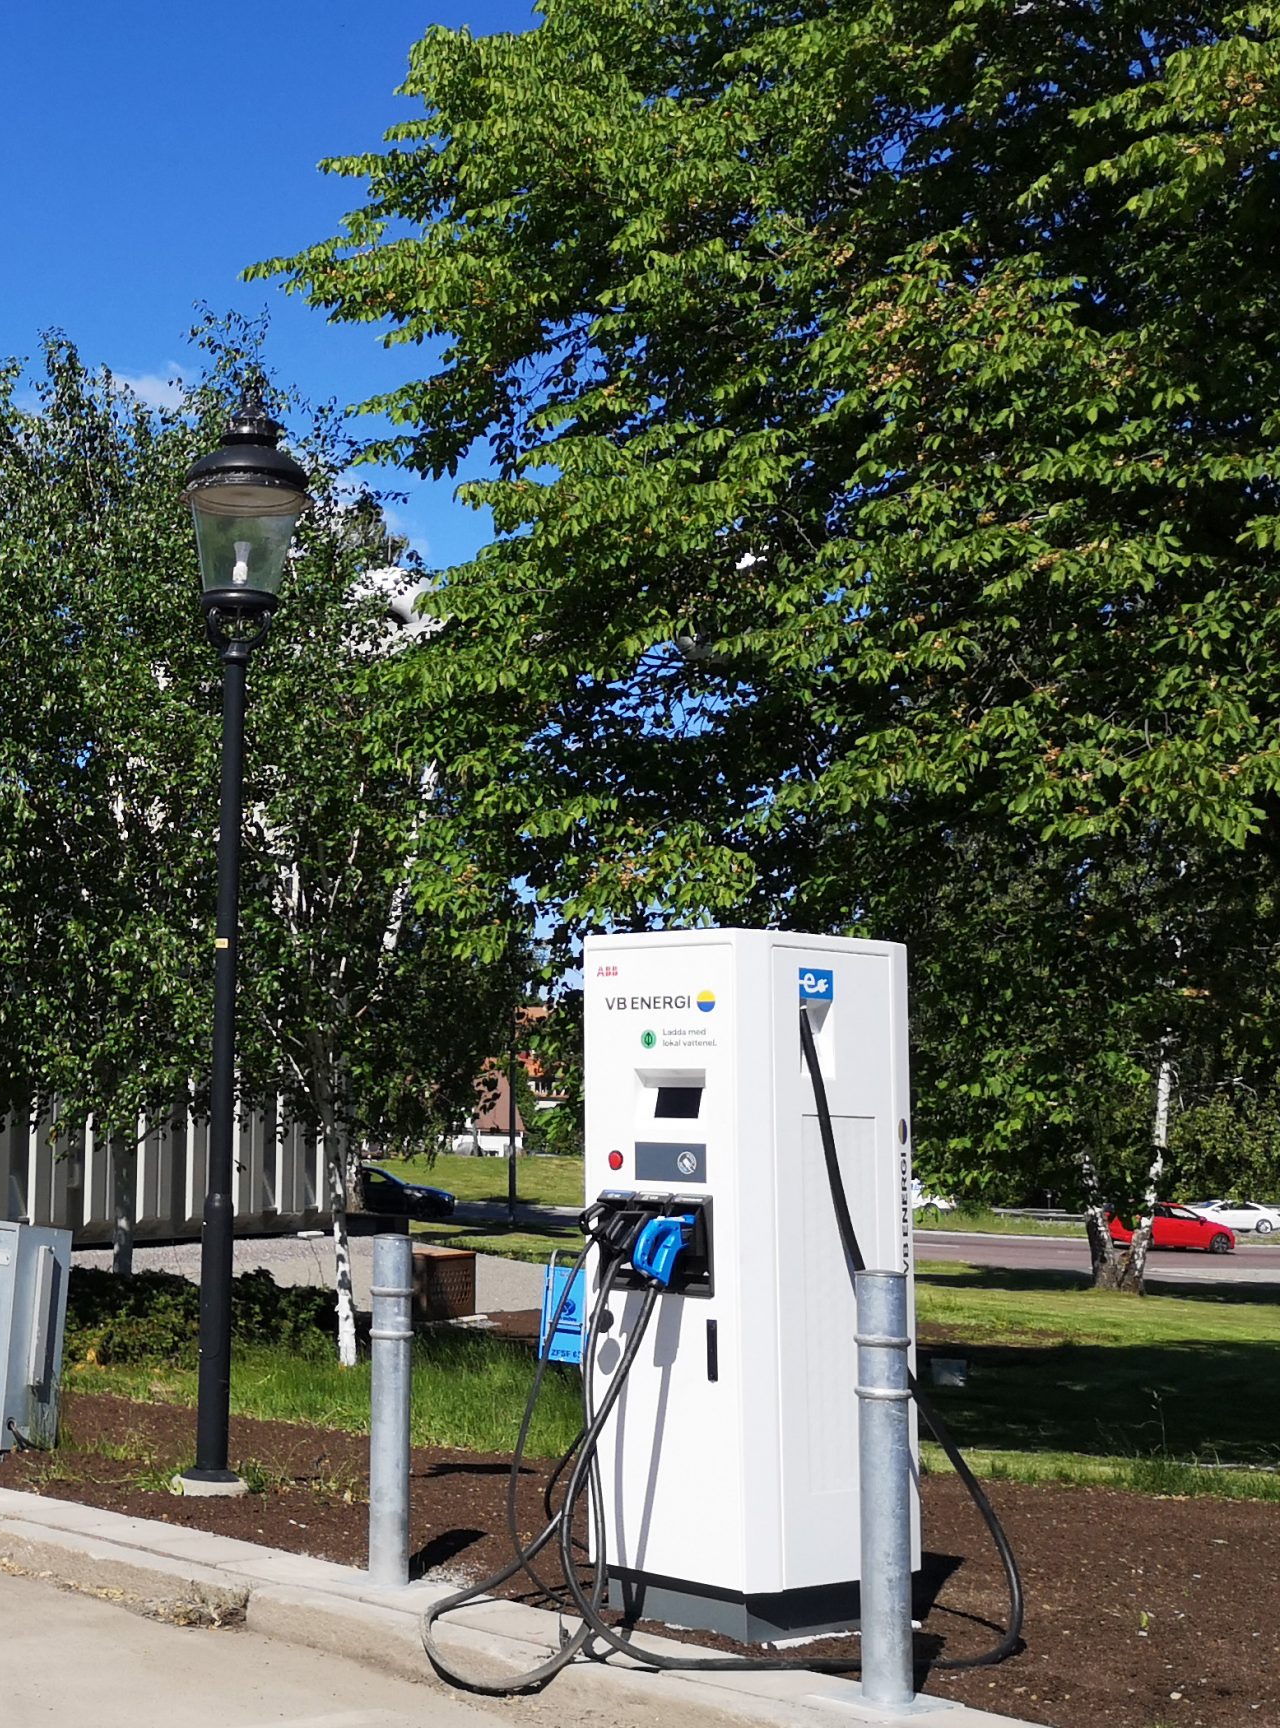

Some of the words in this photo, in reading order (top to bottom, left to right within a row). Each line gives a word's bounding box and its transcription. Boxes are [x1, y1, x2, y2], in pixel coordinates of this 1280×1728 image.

[597, 966, 618, 977] ABB
[605, 997, 627, 1010] VB
[631, 995, 691, 1010] ENERGI
[663, 1028, 687, 1036] Ladda
[688, 1028, 706, 1036] med
[903, 1243, 909, 1273] VB
